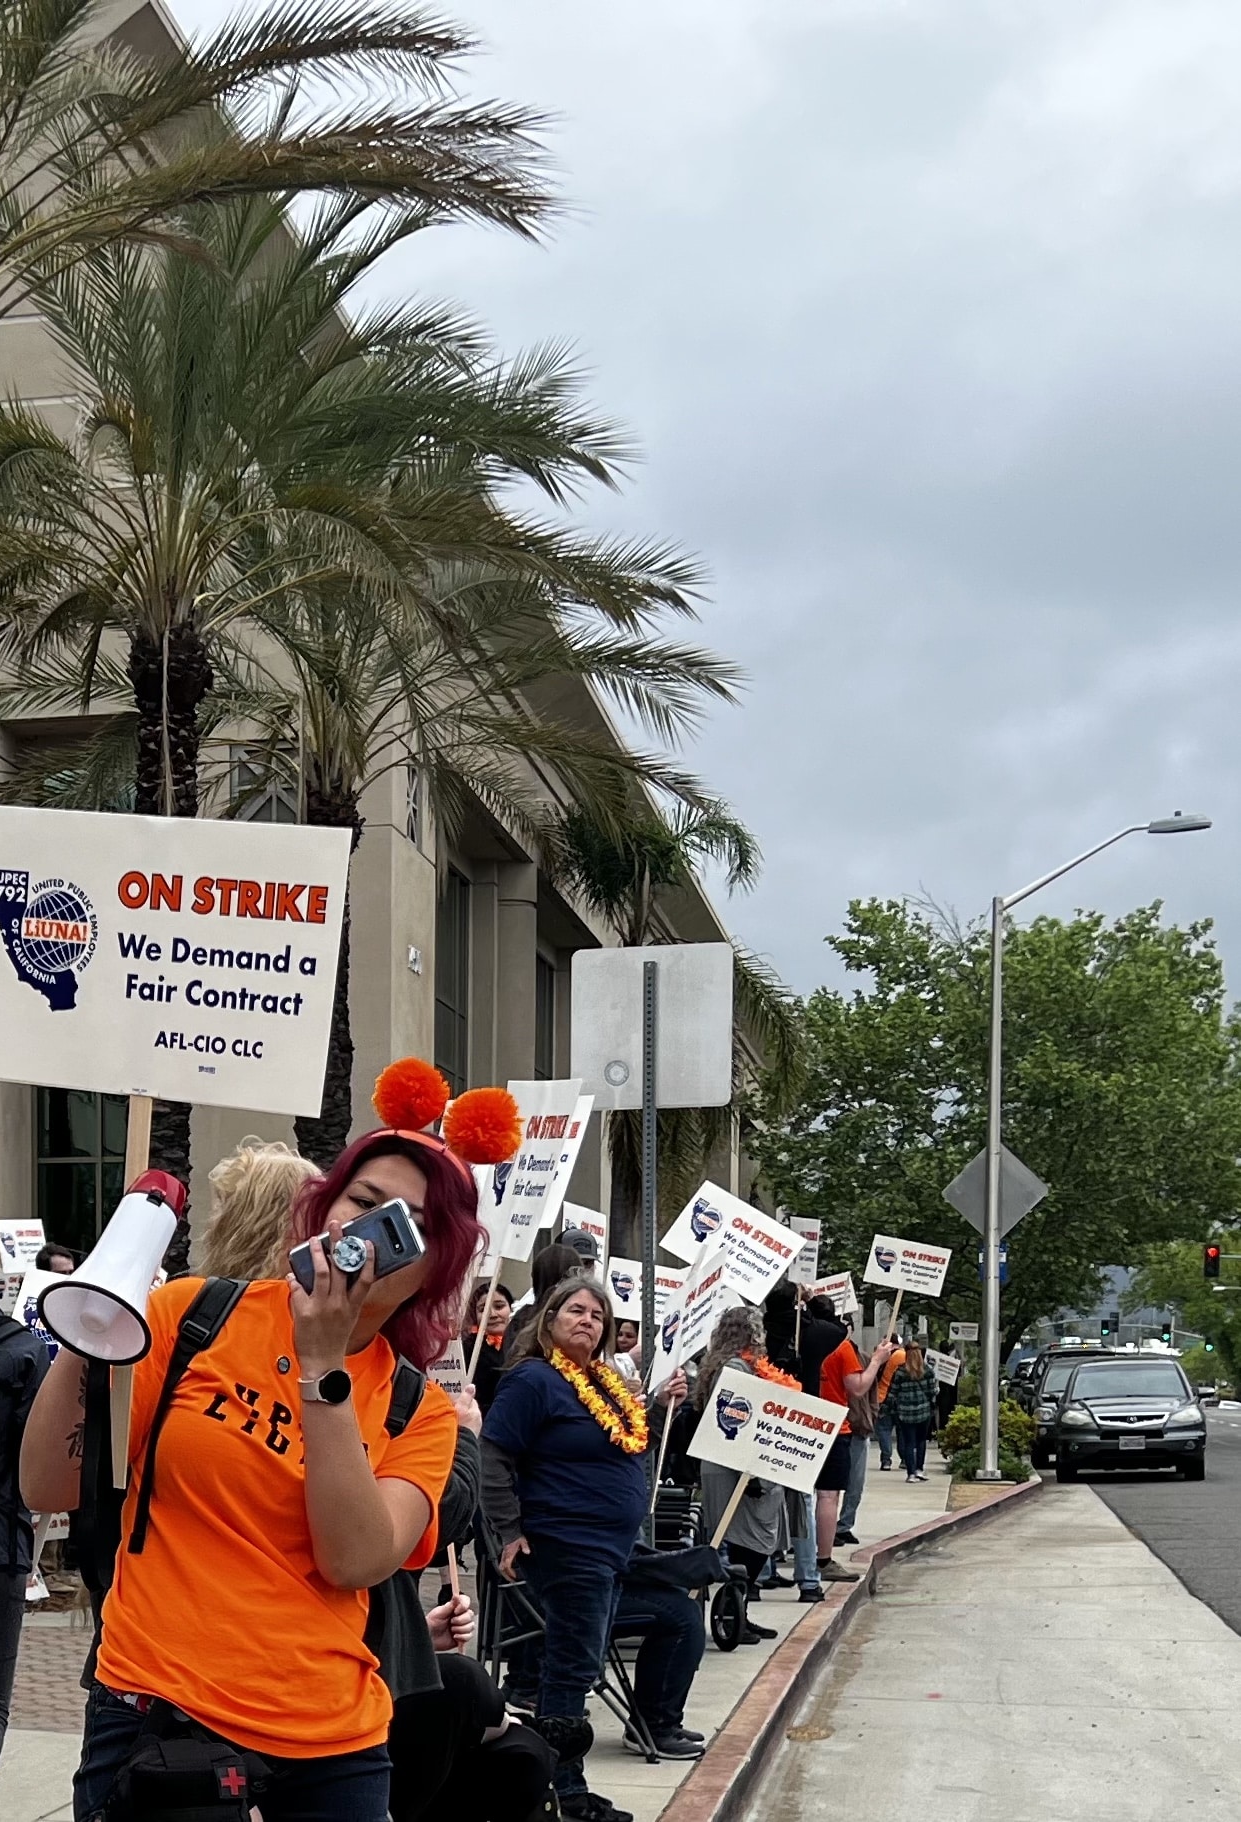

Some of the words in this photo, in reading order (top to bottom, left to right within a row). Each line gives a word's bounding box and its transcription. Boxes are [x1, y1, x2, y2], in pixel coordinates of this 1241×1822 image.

[32, 879, 65, 894] UNITED
[67, 882, 94, 912] PUBLIC
[118, 870, 183, 912] ON
[191, 876, 329, 924] STRIKE
[11, 918, 19, 935] OF
[24, 919, 88, 941] LiUNA!
[12, 939, 57, 985] CALIFORNIA
[117, 932, 162, 961] We
[171, 937, 291, 973] Demand
[299, 956, 317, 976] a
[126, 973, 177, 1003] Fair
[185, 979, 303, 1016] Contract
[154, 1031, 227, 1055] AFL-CIO
[231, 1039, 264, 1059] CLC
[526, 1116, 542, 1139] ON
[723, 1230, 737, 1244] We
[738, 1241, 774, 1266] Demand
[732, 1217, 753, 1235] ON
[751, 1230, 793, 1260] STRIKE
[736, 1252, 771, 1278] Contract
[757, 1419, 772, 1432] We
[774, 1426, 817, 1448] Demand
[817, 1442, 825, 1450] a
[763, 1401, 788, 1419] ON
[787, 1409, 835, 1435] STRIKE
[753, 1433, 773, 1446] Fair
[775, 1441, 815, 1461] Contract
